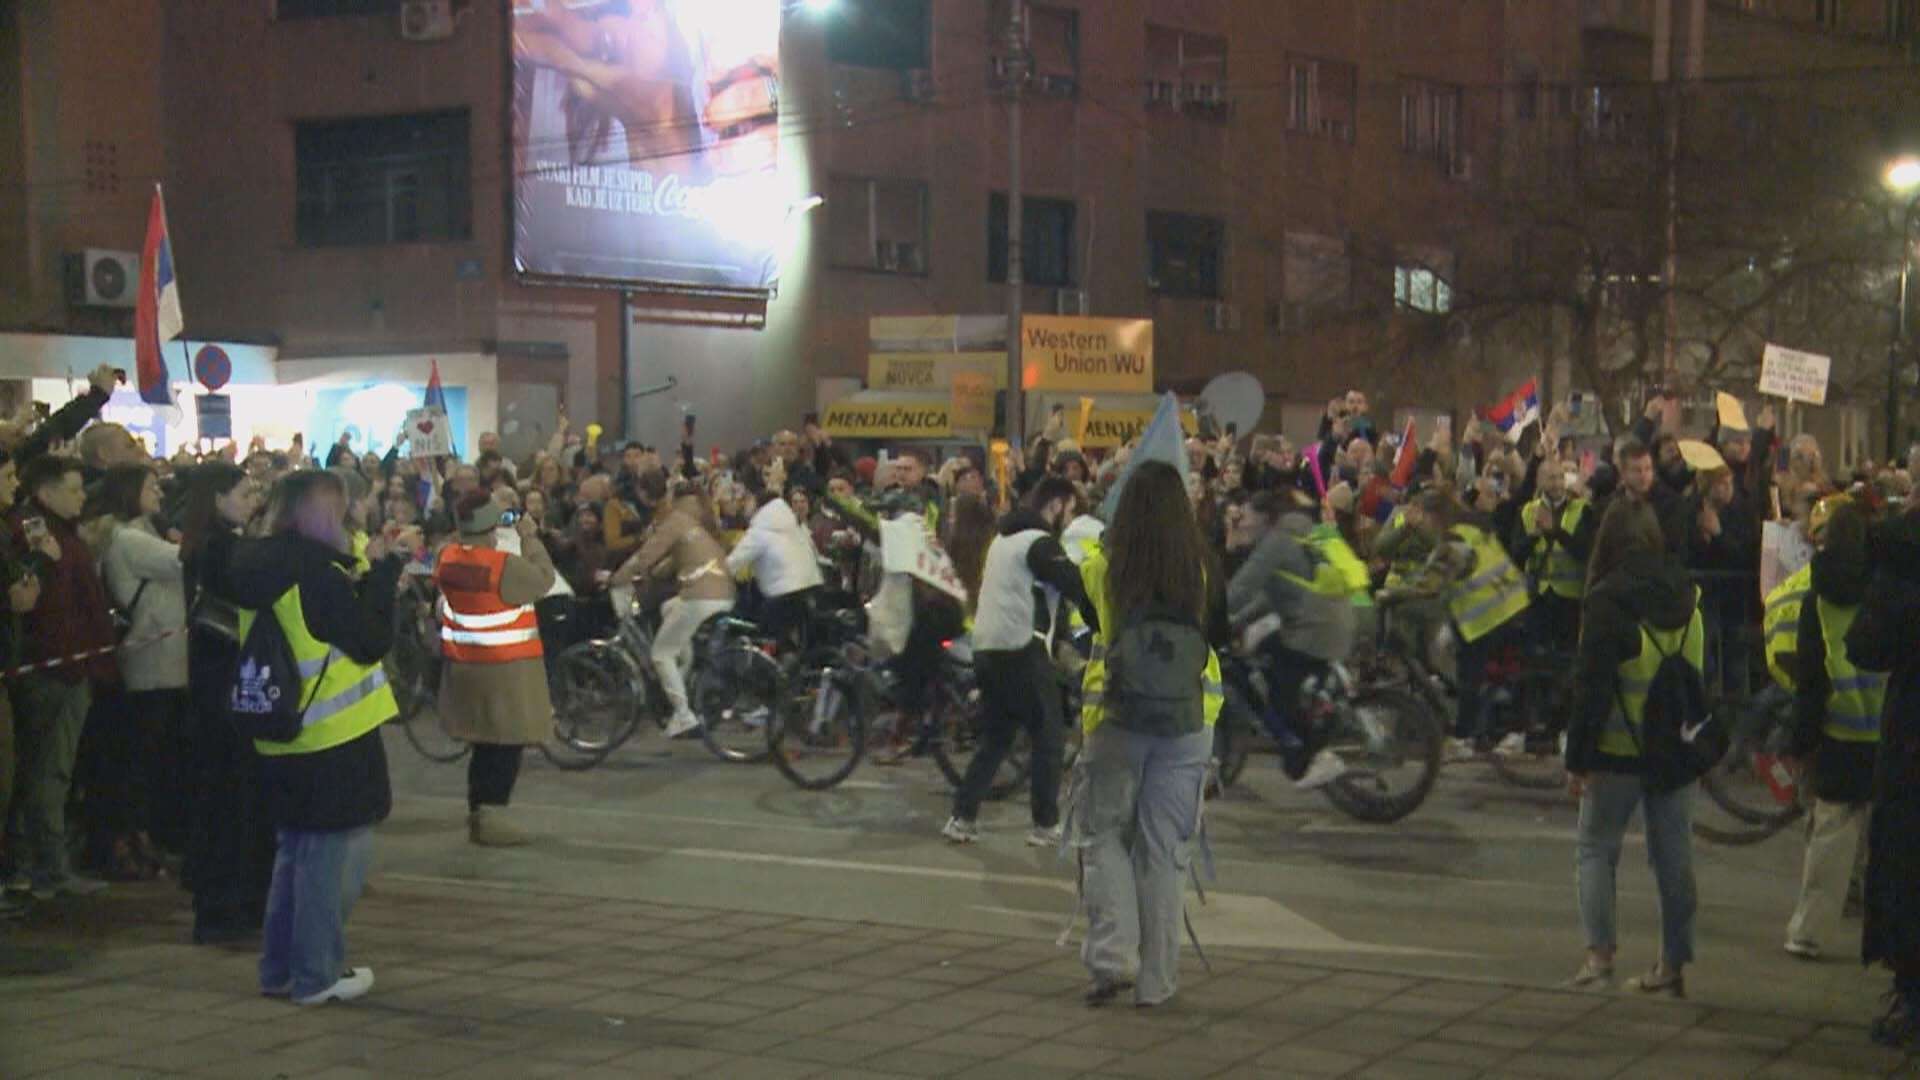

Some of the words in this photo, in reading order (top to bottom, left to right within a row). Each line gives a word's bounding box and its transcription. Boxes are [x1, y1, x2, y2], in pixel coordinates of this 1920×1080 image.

[573, 166, 600, 185] FILM
[617, 169, 653, 192] SUPER
[566, 186, 591, 208] KAD
[593, 189, 608, 209] JE
[1025, 326, 1106, 350] Western
[1053, 352, 1107, 375] Union
[1113, 354, 1145, 374] WU
[827, 407, 948, 429] MENJAČNICA
